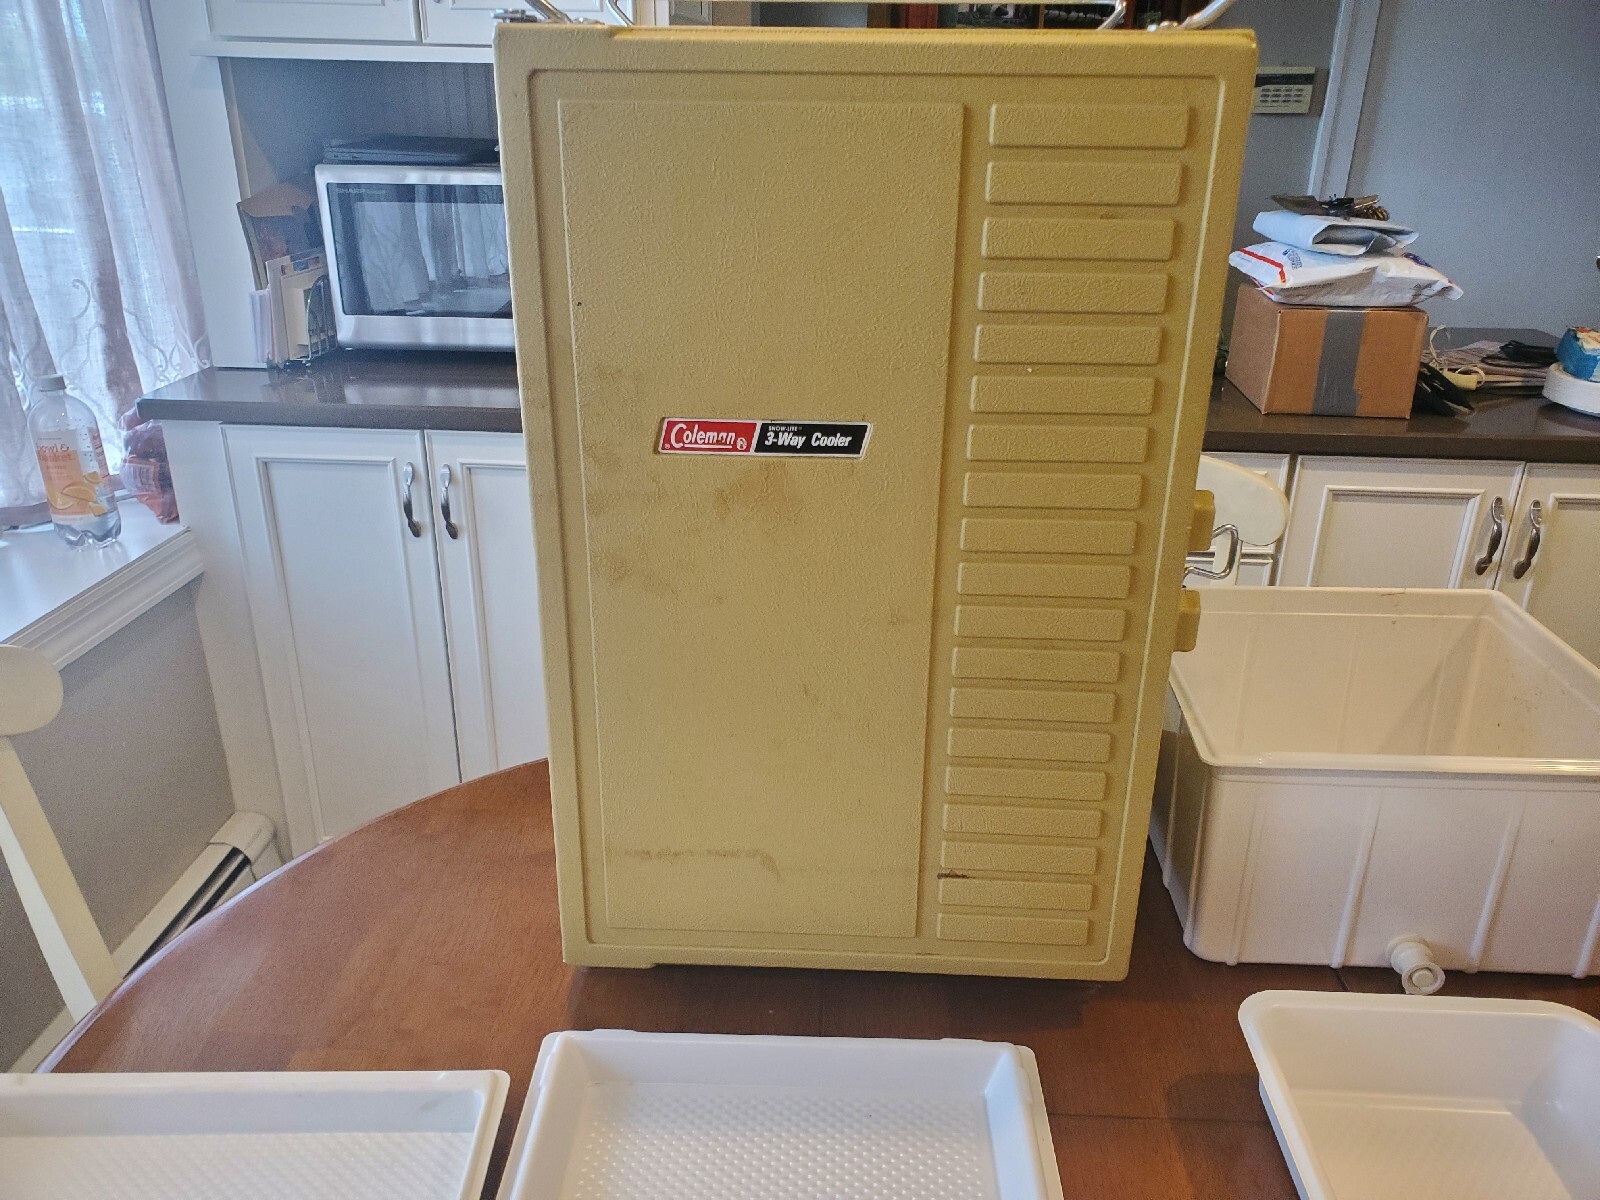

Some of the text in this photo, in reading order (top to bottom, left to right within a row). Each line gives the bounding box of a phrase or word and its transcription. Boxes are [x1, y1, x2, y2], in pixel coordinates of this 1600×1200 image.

[671, 423, 735, 448] Coleman
[764, 431, 852, 449] 3-Way Cooler
